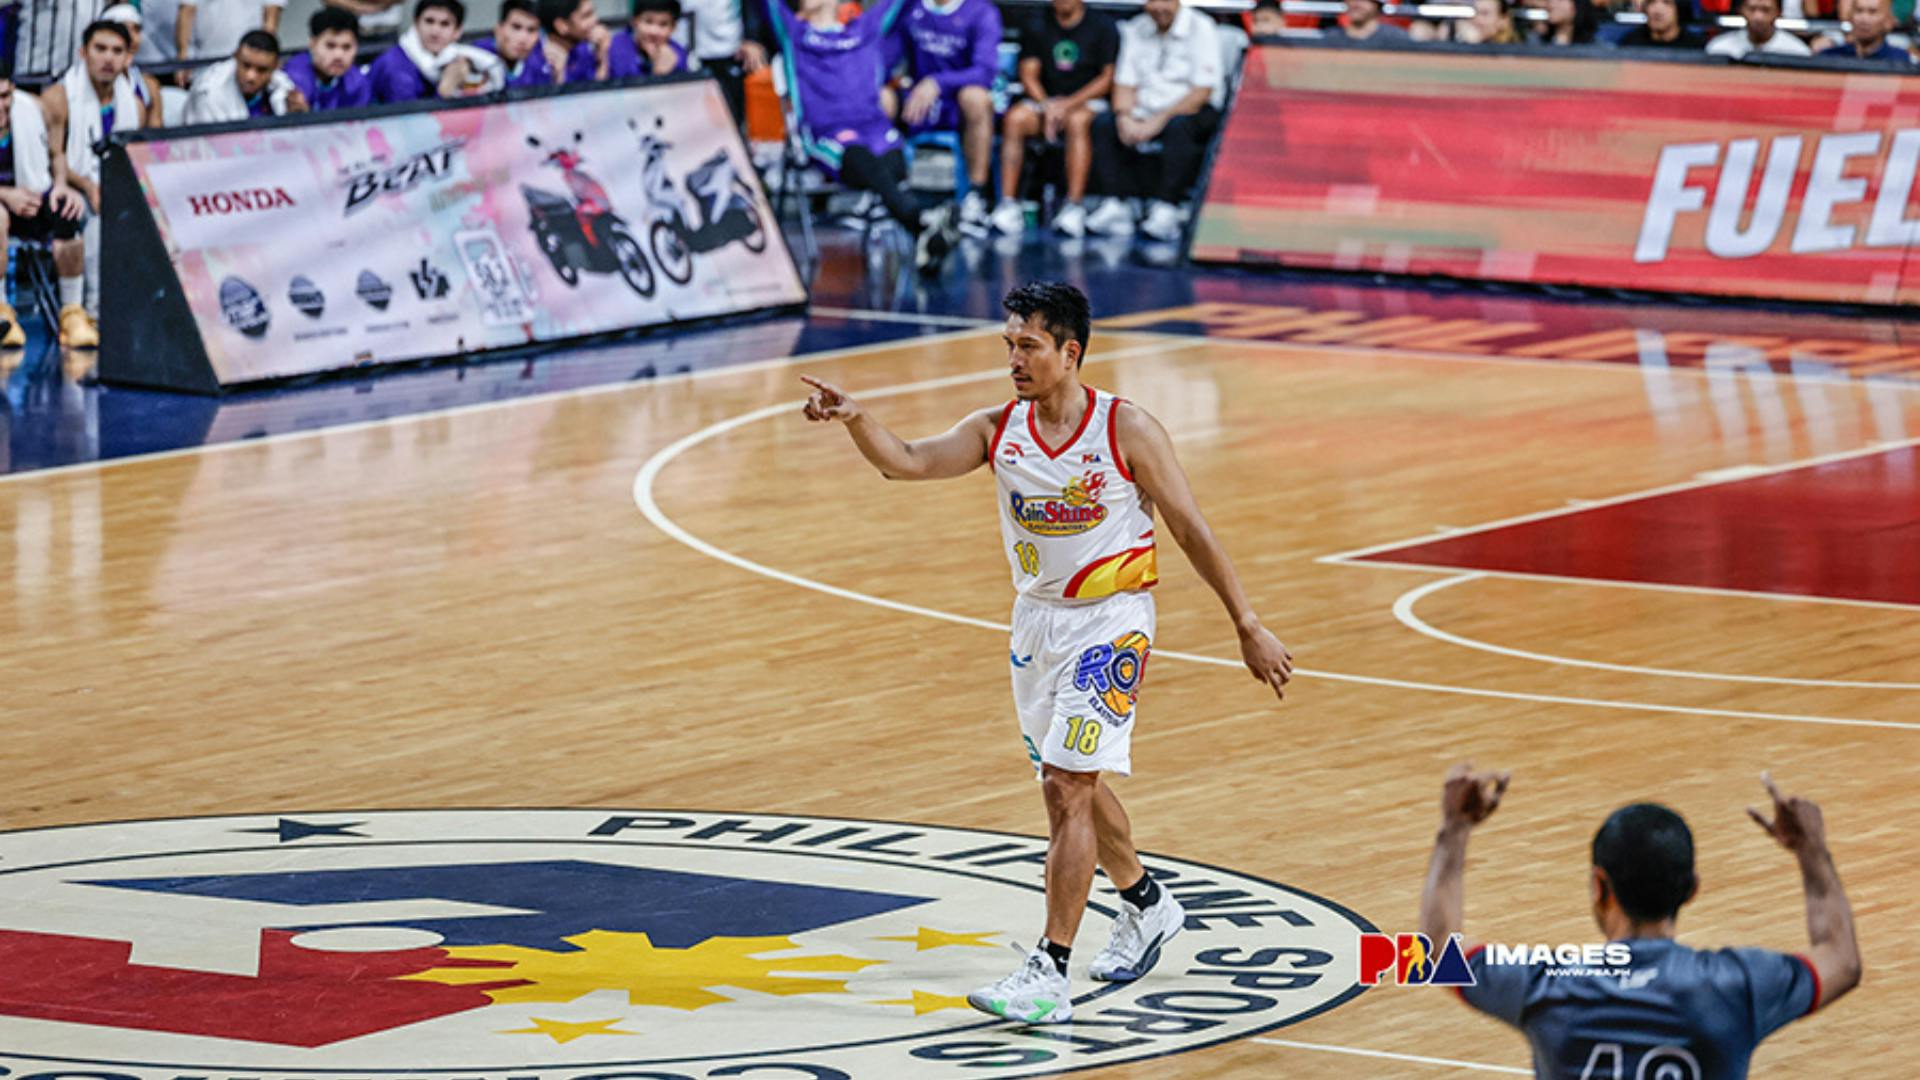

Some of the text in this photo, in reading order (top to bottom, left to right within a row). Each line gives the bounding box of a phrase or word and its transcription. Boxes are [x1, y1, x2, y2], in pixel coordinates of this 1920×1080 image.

[188, 186, 296, 215] HONDA
[1634, 128, 1920, 263] FUEL
[1063, 715, 1102, 756] 18
[908, 946, 1335, 1068] SPORTS
